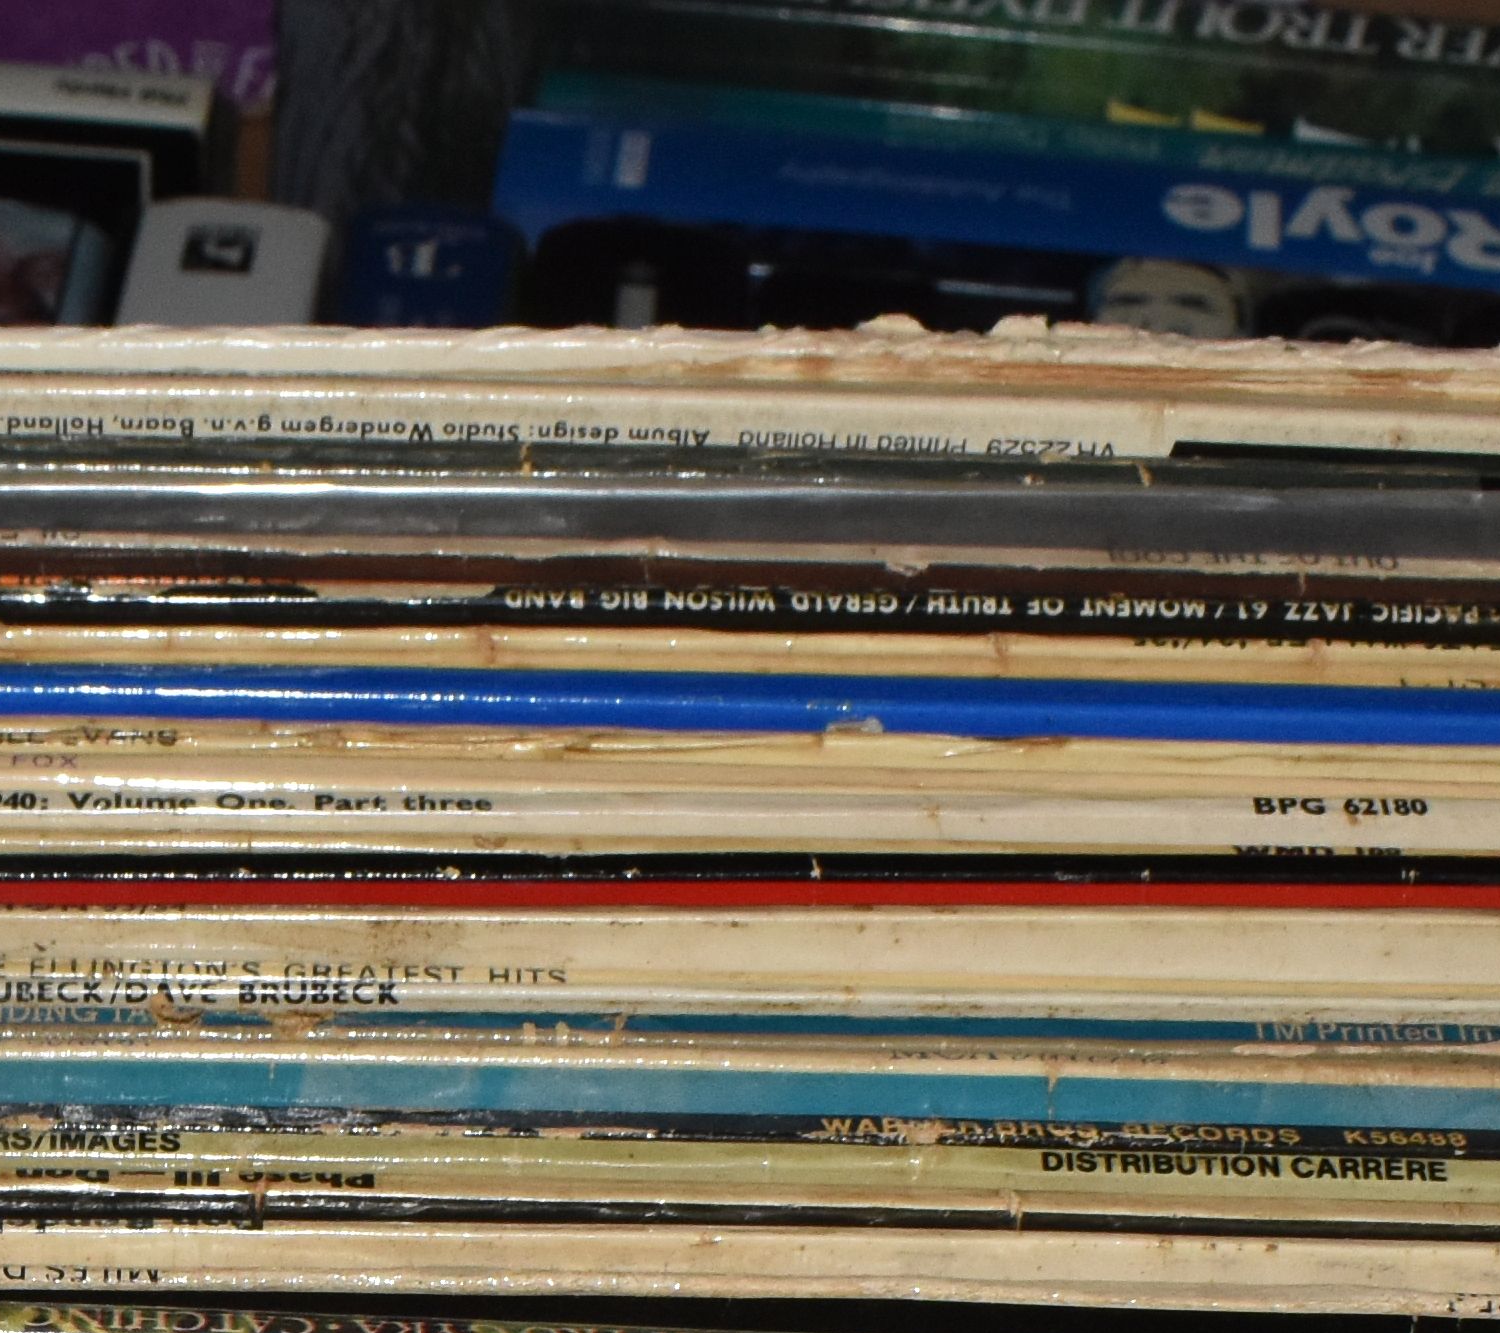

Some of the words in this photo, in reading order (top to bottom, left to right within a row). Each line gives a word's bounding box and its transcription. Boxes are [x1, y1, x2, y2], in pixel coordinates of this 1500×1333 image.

[4, 415, 105, 435] Holland.
[116, 413, 195, 437] Baarn,
[277, 418, 434, 442] Wondergem
[442, 421, 516, 439] Studio
[628, 427, 712, 447] Album
[505, 589, 588, 610] BAND
[601, 589, 649, 610] BIG
[663, 589, 776, 613] WILSON
[790, 590, 896, 617] GERALD
[927, 591, 1012, 618] TRUTH
[1028, 596, 1064, 616] OF
[1080, 595, 1208, 620] MOMENT
[1238, 602, 1268, 621] 61
[1282, 602, 1359, 622] JAZZ
[1373, 603, 1483, 624] PACIFIC
[9, 752, 79, 769] FOX
[66, 791, 198, 813] Volume
[313, 793, 387, 813] Part
[403, 793, 494, 813] three
[1252, 796, 1327, 818] BPG
[1343, 796, 1428, 818] 62180
[489, 965, 568, 984] HITS
[238, 980, 399, 1005] BRUBECK
[1041, 1151, 1281, 1180] DISTRIBUTION
[1291, 1155, 1448, 1184] CARRERE
